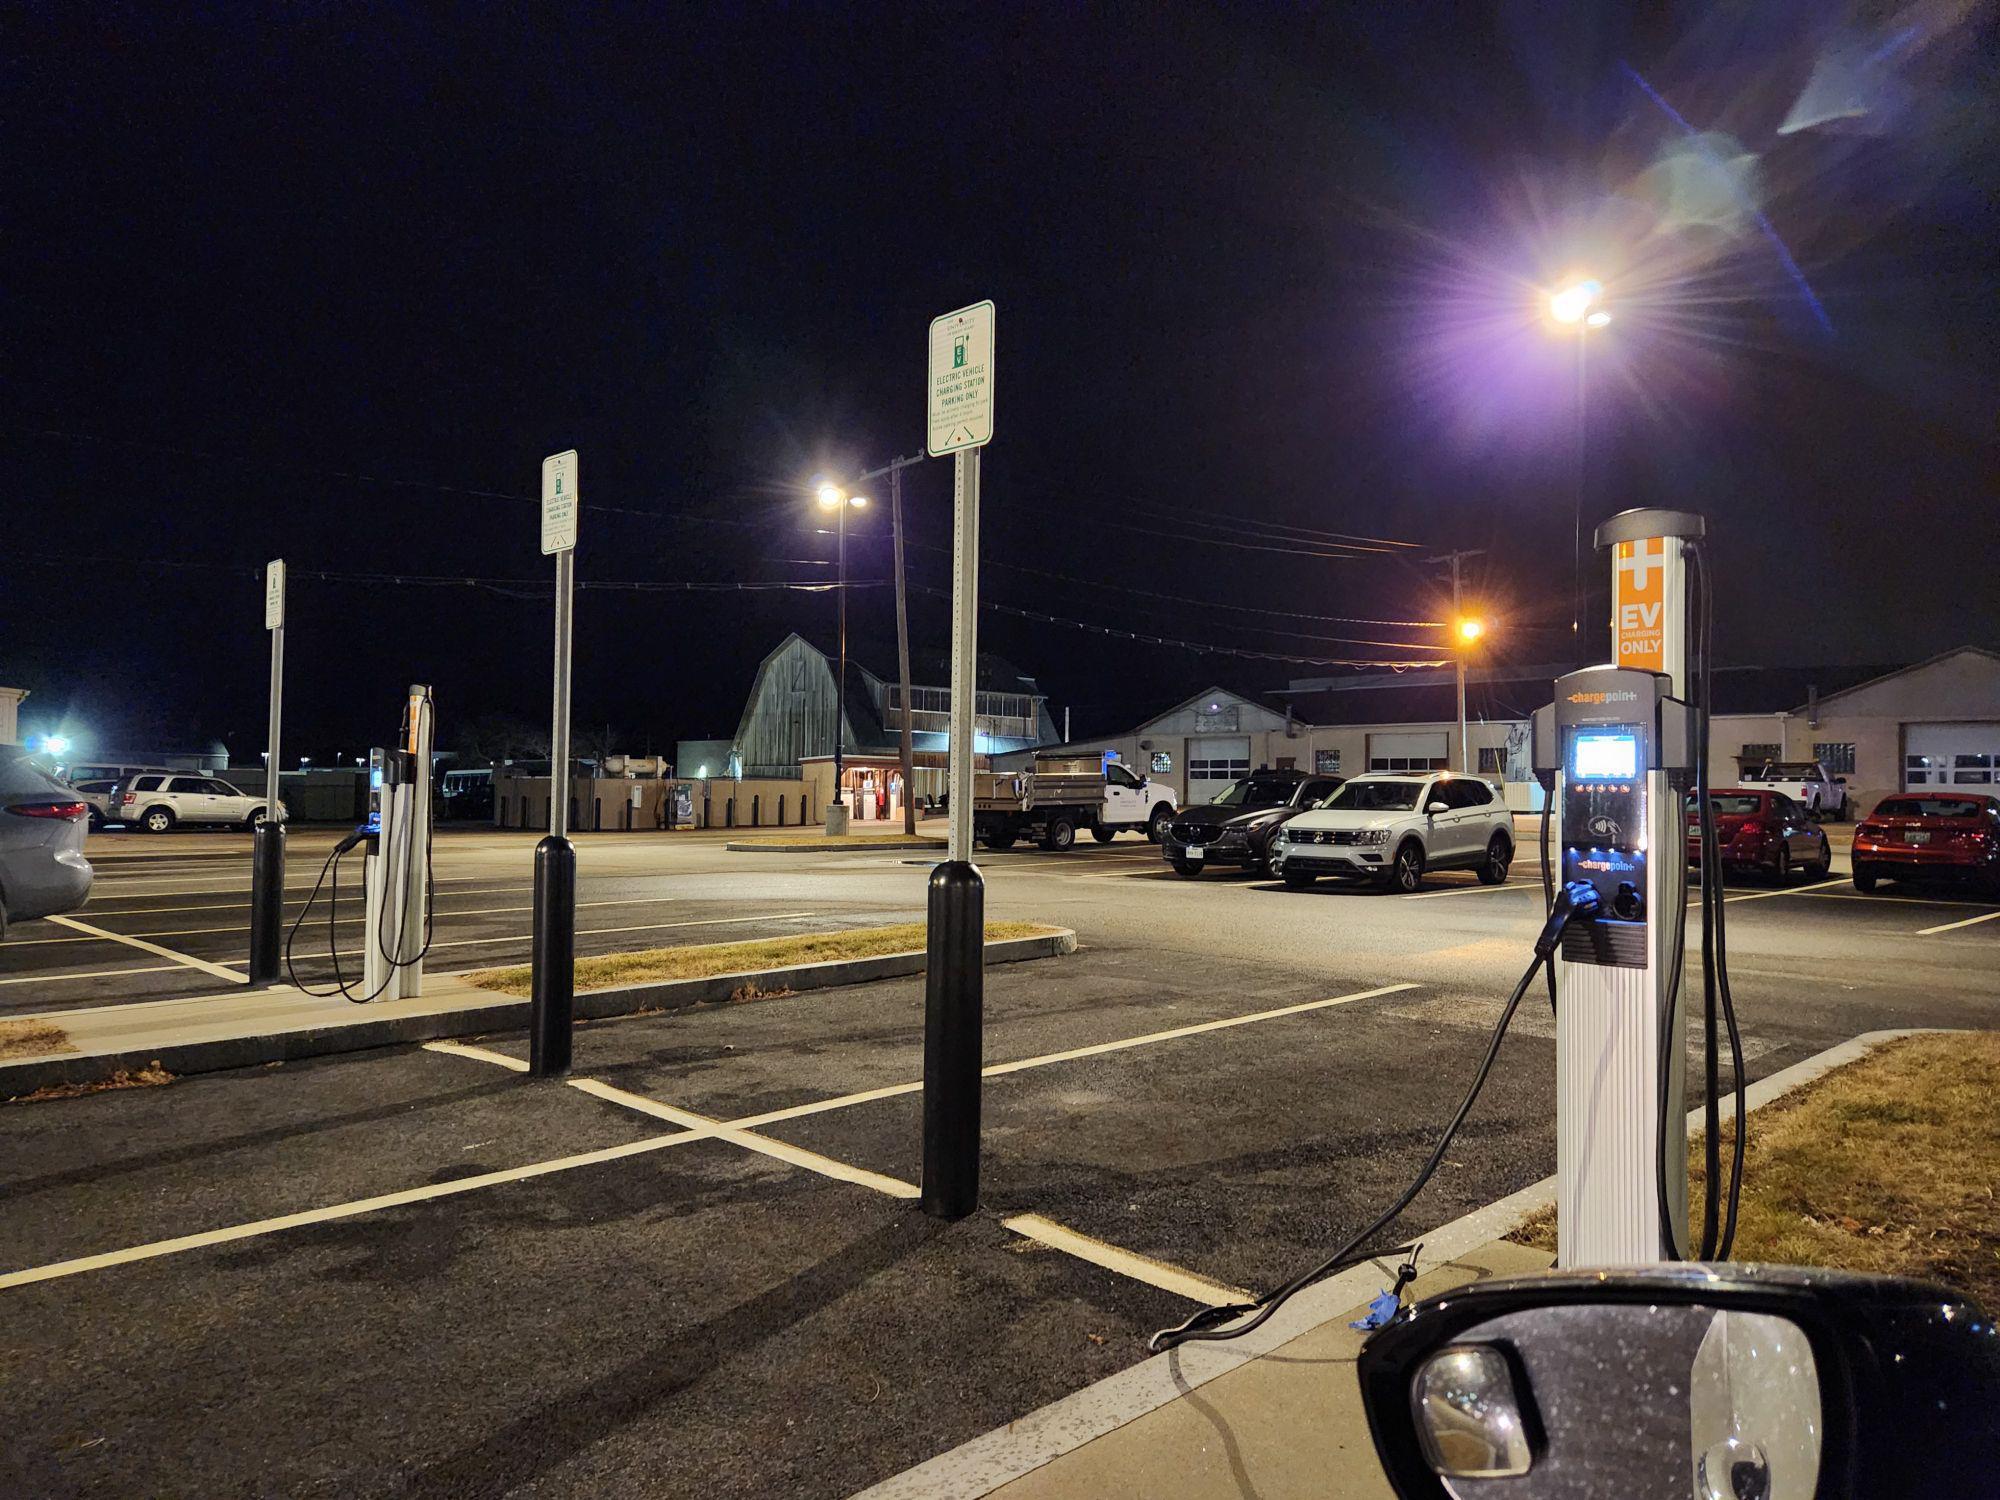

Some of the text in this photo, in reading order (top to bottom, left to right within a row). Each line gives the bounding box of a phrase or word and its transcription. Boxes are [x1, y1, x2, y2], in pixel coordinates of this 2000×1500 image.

[937, 364, 985, 386] ELECTRIC VEHICLE
[936, 377, 985, 397] CHARGING STATION
[942, 395, 964, 408] PARKING
[965, 389, 979, 401] ONLY
[1621, 602, 1662, 630] EV
[1621, 629, 1661, 640] CHARGING
[1620, 639, 1662, 655] ONLY
[1568, 690, 1637, 705] chargepoint
[1578, 859, 1635, 872] chargepoint
